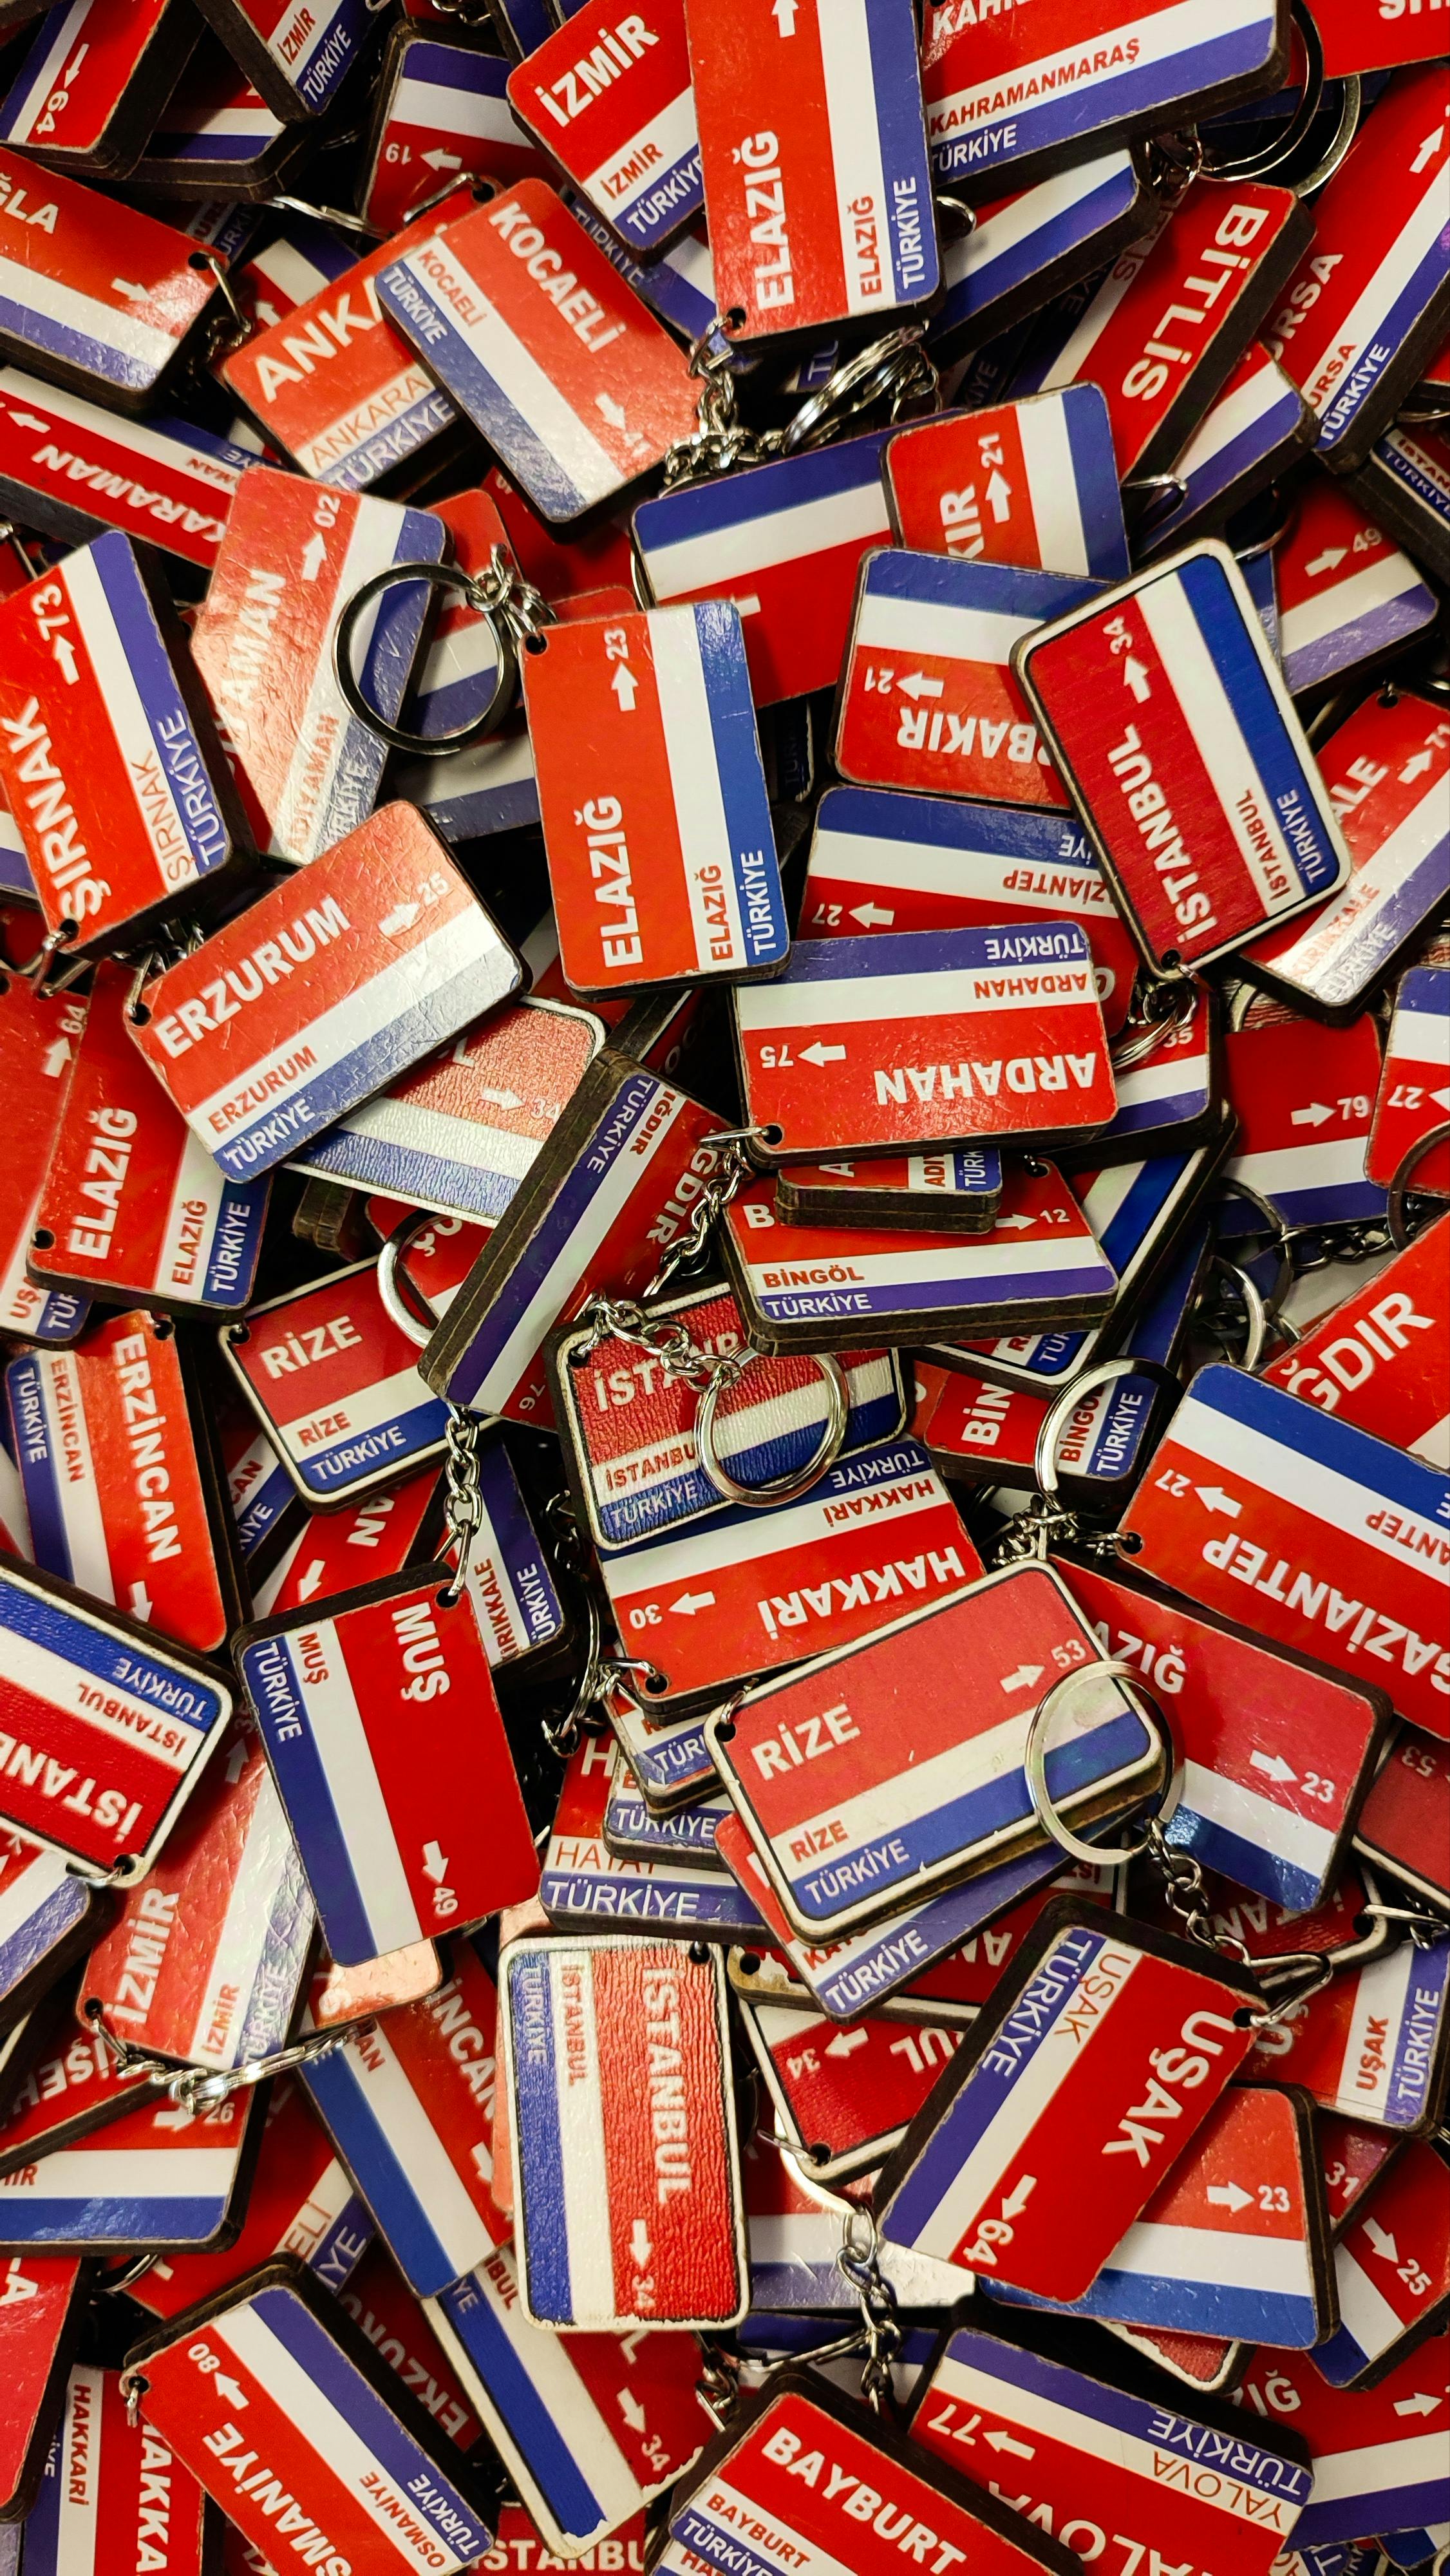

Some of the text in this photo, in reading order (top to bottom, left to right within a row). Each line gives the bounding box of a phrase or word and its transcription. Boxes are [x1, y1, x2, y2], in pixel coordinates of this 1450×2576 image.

[276, 8, 318, 66] İZMİR
[301, 24, 352, 103] TÜRKİYE
[534, 14, 660, 128] İZMİR
[36, 91, 68, 135] 64
[930, 37, 1141, 136] KAHRAMANMARAŞ
[386, 143, 412, 166] 19
[600, 142, 664, 200] İZMİR
[733, 130, 795, 310] ELAZIĞ
[847, 195, 883, 298] ELAZIĞ
[893, 176, 926, 290] TÜRKİYE
[384, 267, 449, 345] TÜRKİYE
[417, 250, 487, 328] KOCAELİ
[489, 201, 627, 354] KOCAELİ
[1122, 204, 1270, 401] BİTLİS
[1267, 254, 1344, 362] URSA
[1310, 344, 1357, 410] URSA
[1320, 343, 1391, 442] TÜRKİYE
[311, 372, 431, 471] ANKARA
[329, 395, 455, 493] TÜRKİYE
[978, 433, 1004, 468] 21
[314, 494, 341, 529] 02
[1352, 526, 1383, 554] 49
[30, 583, 71, 641] 73
[604, 629, 629, 661] 23
[1103, 616, 1134, 655] 34
[864, 666, 895, 694] 21
[1, 696, 112, 922] ŞIRNAK
[130, 748, 193, 882] ŞIRNAK
[157, 709, 227, 867] TÜRKİYE
[1107, 723, 1218, 943] İSTANBUL
[1235, 788, 1292, 901] İSTANBUL
[1276, 788, 1330, 884] TÜRKİYE
[415, 873, 449, 906] 25
[573, 795, 644, 969] ELAZIĞ
[693, 865, 734, 961] ELAZIĞ
[740, 849, 777, 957] TÜRKİYE
[812, 904, 843, 927] 27
[1003, 869, 1109, 905] ZİANTEP
[155, 897, 352, 1059] ERZURUM
[974, 972, 1088, 999] ARDAHAN
[984, 933, 1084, 960] TÜRKİYE
[208, 1045, 318, 1133] ERZURUM
[760, 1044, 794, 1069] 75
[874, 1052, 1096, 1106] ARDAHAN
[225, 1098, 317, 1170] TÜRKİYE
[586, 1079, 654, 1174] TÜRKİYE
[628, 1090, 676, 1156] IĞDIR
[1337, 1096, 1369, 1121] 79
[1388, 1084, 1426, 1111] 27
[68, 1106, 138, 1260] ELAZIĞ
[646, 1127, 722, 1245] ĞDIR
[1040, 1208, 1071, 1224] 12
[171, 1199, 208, 1285] ELAZIĞ
[211, 1200, 251, 1293] TÜRKİYE
[764, 1264, 865, 1289] BİNGÖL
[766, 1293, 872, 1318] TÜRKİYE
[259, 1315, 362, 1379] RİZE
[1280, 1292, 1436, 1412] ĞDIR
[15, 1367, 49, 1464] TÜRKİYE
[50, 1359, 86, 1483] ERZİNCAN
[297, 1410, 351, 1448] RİZE
[518, 1382, 546, 1412] 76
[1096, 1391, 1144, 1472] TÜRKİYE
[113, 1332, 184, 1564] ERZİNCAN
[311, 1425, 408, 1481] TÜRKİYE
[605, 1447, 695, 1490] İSTANBU
[831, 1448, 925, 1490] TÜRKİYE
[1154, 1468, 1192, 1498] 27
[611, 1480, 699, 1530] TÜRKİYE
[824, 1478, 935, 1528] HAKKARİ
[1364, 1510, 1450, 1571] ANTEP
[516, 1562, 554, 1643] ÜRKİYE
[629, 1604, 663, 1629] 30
[757, 1546, 966, 1640] HAKKARİ
[114, 1656, 208, 1722] TÜRKİYE
[297, 1631, 330, 1687] MUŞ
[391, 1601, 451, 1702] MUŞ
[1051, 1638, 1087, 1669] 53
[77, 1681, 187, 1759] İSTANBUL
[253, 1638, 303, 1744] TÜRKİYE
[750, 1703, 862, 1782] RİZE
[1400, 1745, 1437, 1777] 53
[0, 1739, 143, 1844] İSTAN
[1301, 1771, 1337, 1803] 23
[789, 1819, 850, 1864] RİZE
[805, 1837, 910, 1906] TÜRKİYE
[433, 1886, 460, 1917] 49
[545, 1877, 701, 1922] TÜRKİYE
[102, 1887, 180, 2024] İZMİR
[825, 1929, 929, 2012] TÜRKİYE
[201, 1982, 241, 2056] İZMİR
[561, 1963, 588, 2087] İSTANBUL
[981, 1938, 1094, 2078] TÜRKİYE
[1055, 1952, 1132, 2045] UŞAK
[786, 2047, 822, 2080] 34
[1355, 2015, 1390, 2091] UŞAK
[1397, 1987, 1440, 2103] TÜRKİYE
[205, 2101, 235, 2124] 26
[644, 1966, 693, 2206] İSTANBUL
[1102, 2010, 1238, 2169] UŞAK
[1257, 2184, 1290, 2213] 23
[1325, 2162, 1360, 2199] 31
[962, 2219, 1015, 2271] 64
[1396, 2259, 1433, 2296] 25
[187, 2342, 221, 2374] 80
[68, 2383, 92, 2506] HAKKARİ
[641, 2434, 672, 2473] 34
[927, 2403, 983, 2447] 77
[1147, 2410, 1301, 2496] TÜRKİYE
[202, 2421, 353, 2576] SMANİYE
[359, 2471, 446, 2569] OSMANİYE
[407, 2472, 481, 2556] TÜRKİYE
[761, 2427, 968, 2576] BAYBURT
[1153, 2450, 1282, 2530] YALOVA
[705, 2492, 813, 2570] BAYBURT
